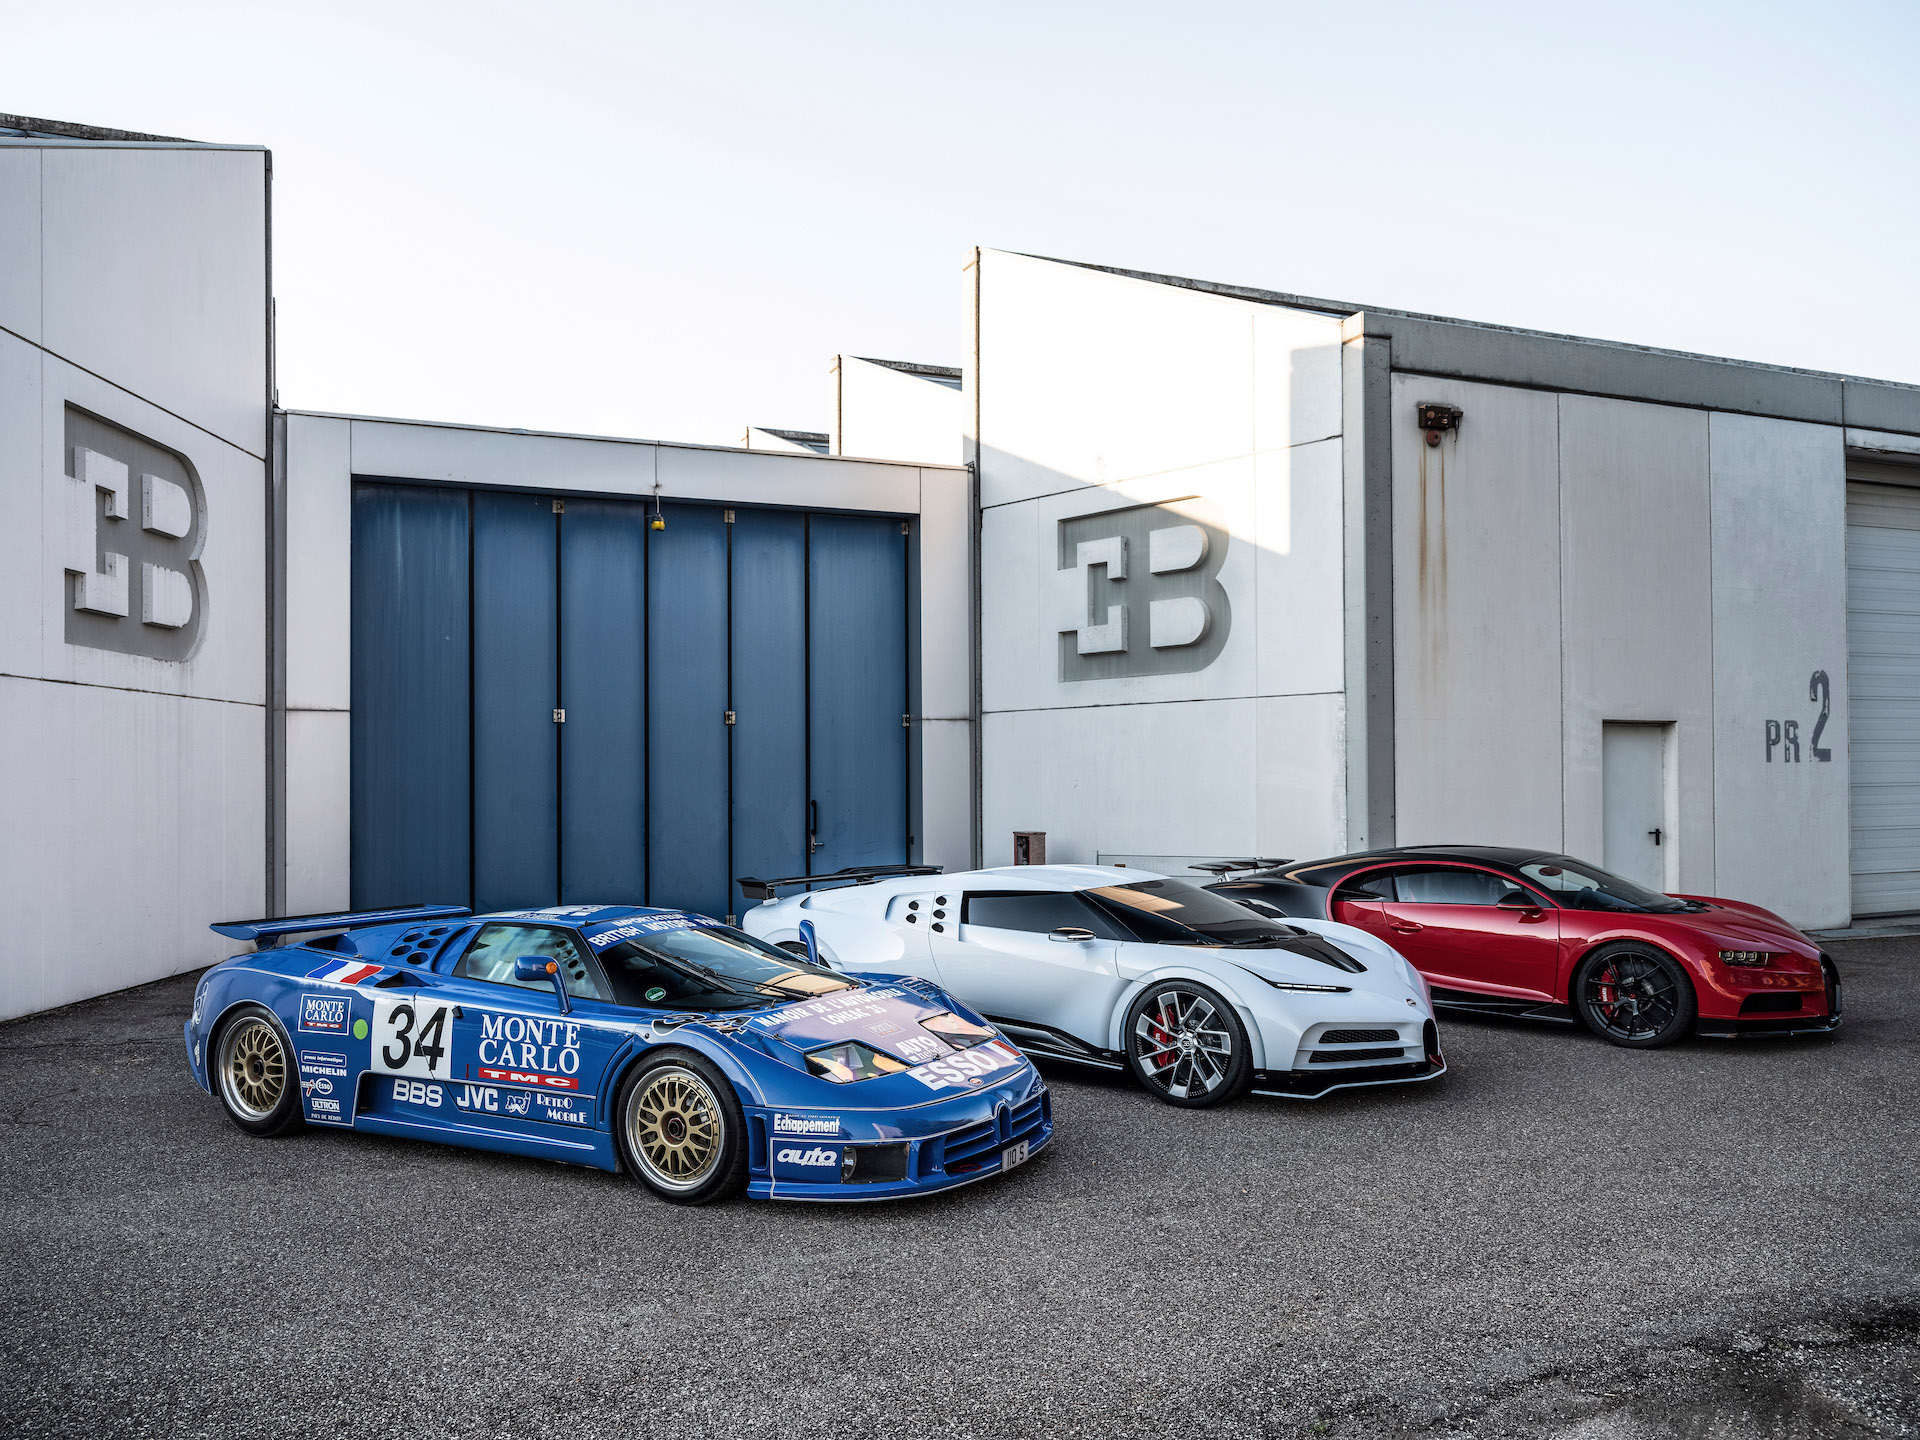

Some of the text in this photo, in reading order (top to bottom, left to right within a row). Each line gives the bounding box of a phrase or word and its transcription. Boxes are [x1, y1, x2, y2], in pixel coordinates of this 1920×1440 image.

[1765, 669, 1832, 763] PR 2
[587, 926, 646, 947] BRITISH
[642, 919, 698, 931] MOTORS
[305, 1009, 344, 1023] CARLO
[306, 999, 345, 1012] MONTE
[753, 1007, 814, 1028] MANOIR
[807, 1002, 832, 1014] DE
[820, 1004, 888, 1026] LOHEAC 35
[306, 1021, 340, 1029] TMC
[480, 1014, 581, 1049] MONTE
[382, 1004, 448, 1071] 34
[895, 1035, 939, 1056] AUTO
[478, 1039, 580, 1074] CARLO
[301, 1065, 348, 1077] MICHELIN
[483, 1069, 571, 1087] TMC
[905, 1050, 1000, 1091] ESSO
[392, 1079, 443, 1108] BBS
[456, 1084, 499, 1111] JVC
[311, 1100, 340, 1110] ULTRON
[774, 1113, 840, 1135] Echappement
[777, 1146, 838, 1164] auto
[1007, 1144, 1025, 1167] 110 S
